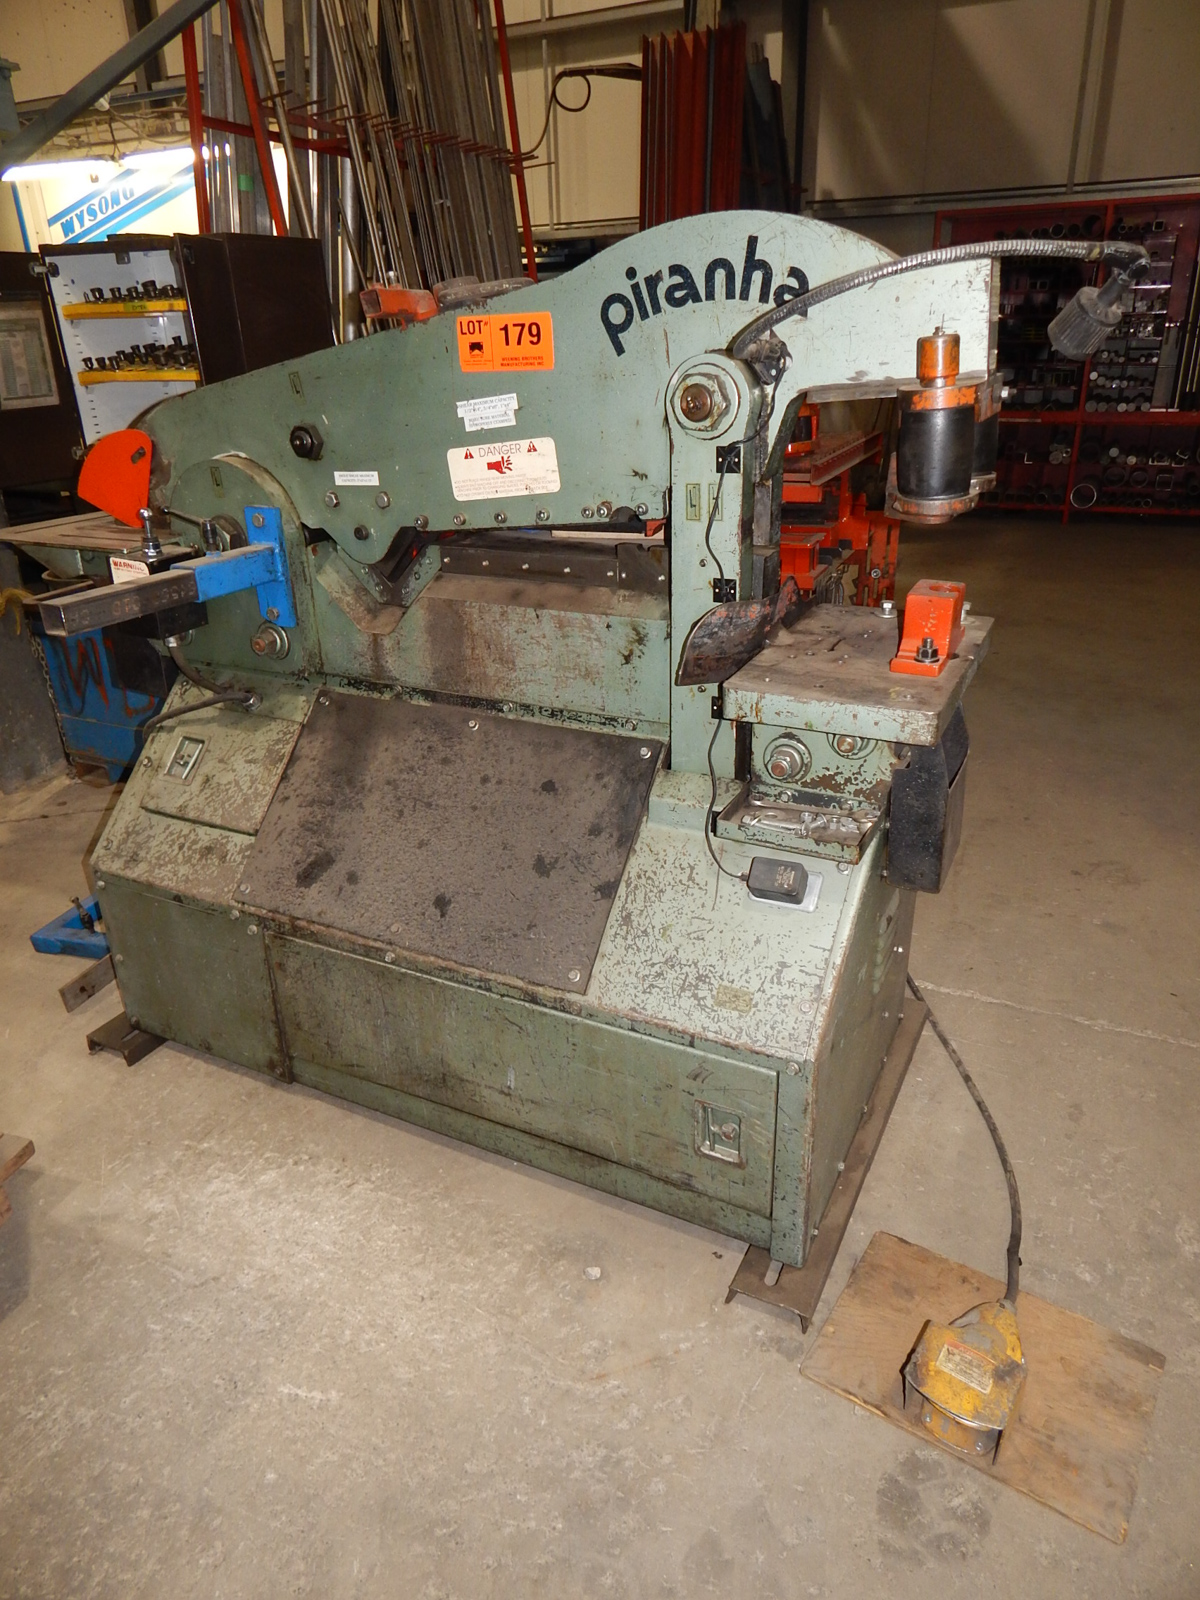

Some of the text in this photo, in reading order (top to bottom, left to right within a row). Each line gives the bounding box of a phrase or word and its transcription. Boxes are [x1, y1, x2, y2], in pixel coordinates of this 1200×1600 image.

[601, 235, 809, 356] piranha
[460, 320, 483, 335] LOT
[499, 322, 541, 346] 179
[479, 443, 521, 457] DANGER
